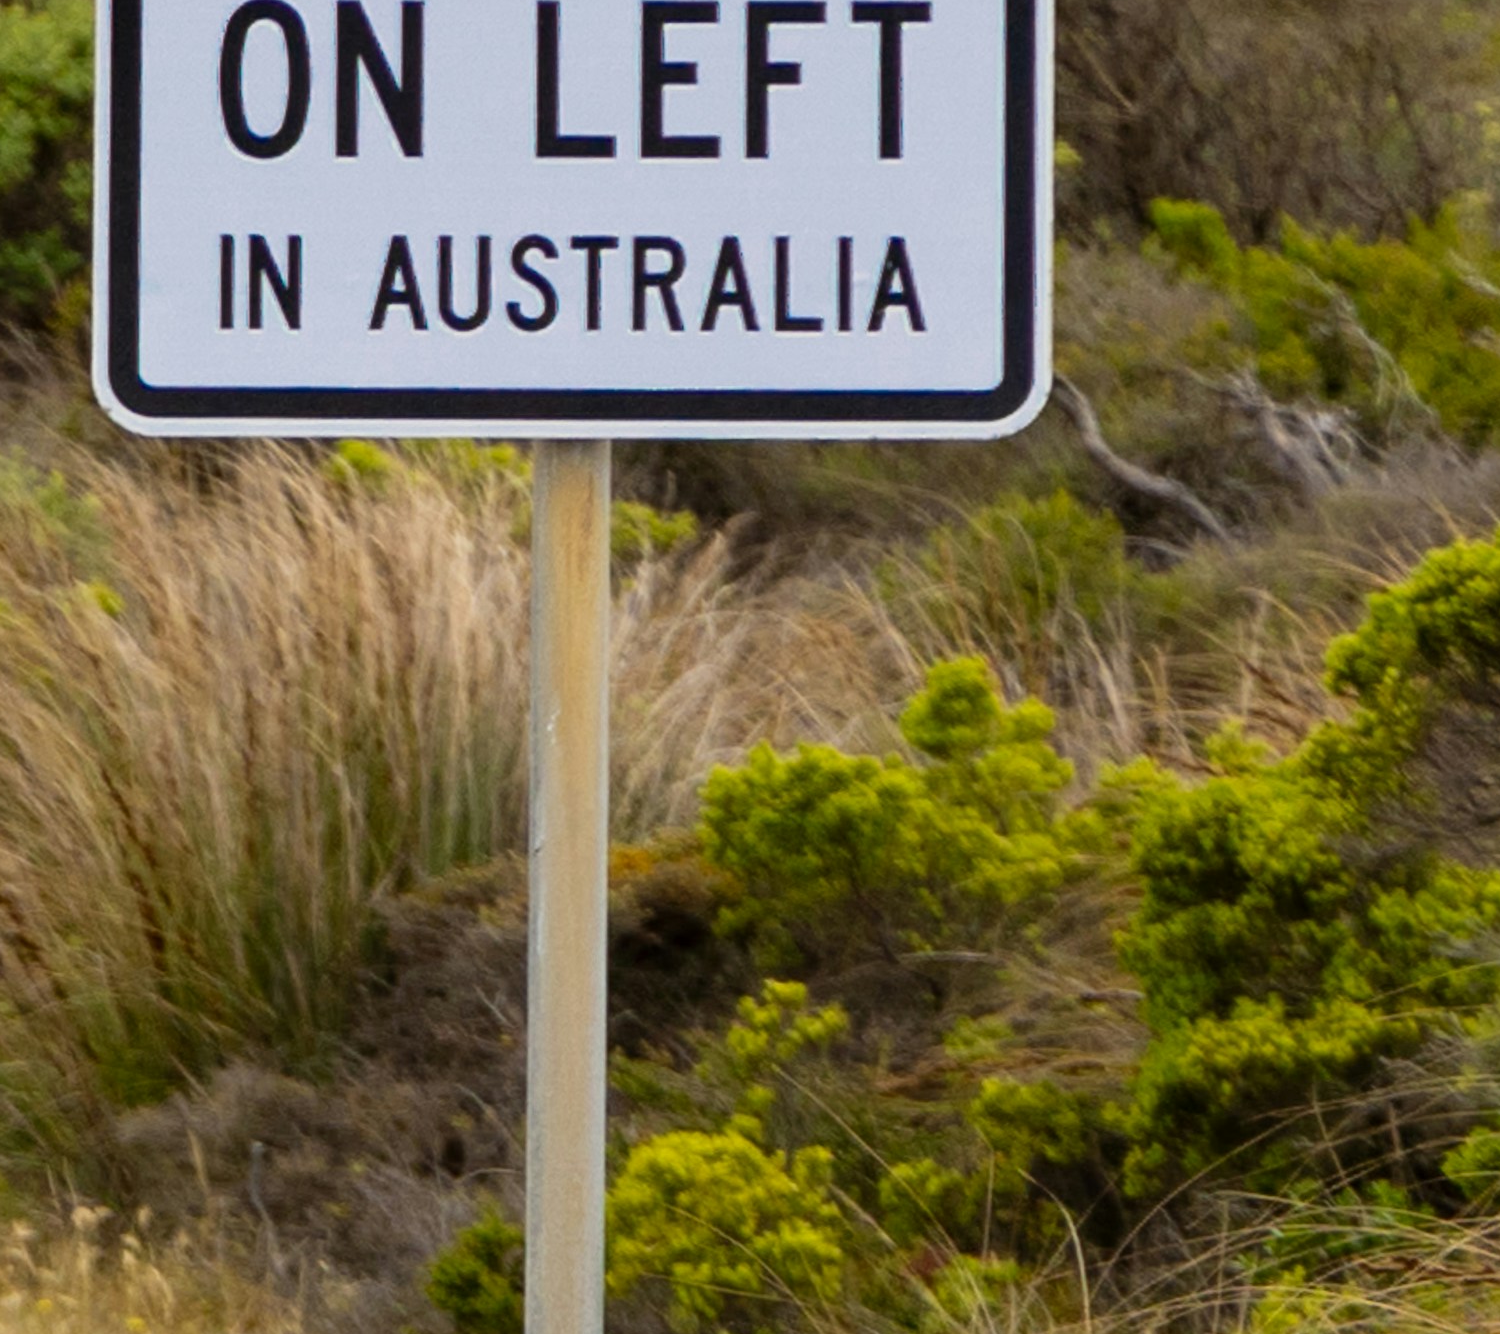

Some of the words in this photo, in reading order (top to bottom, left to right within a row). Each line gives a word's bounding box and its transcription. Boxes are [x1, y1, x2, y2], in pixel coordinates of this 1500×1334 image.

[534, 0, 932, 160] LEFT
[219, 234, 303, 331] IN
[368, 234, 927, 333] AUSTRALIA
